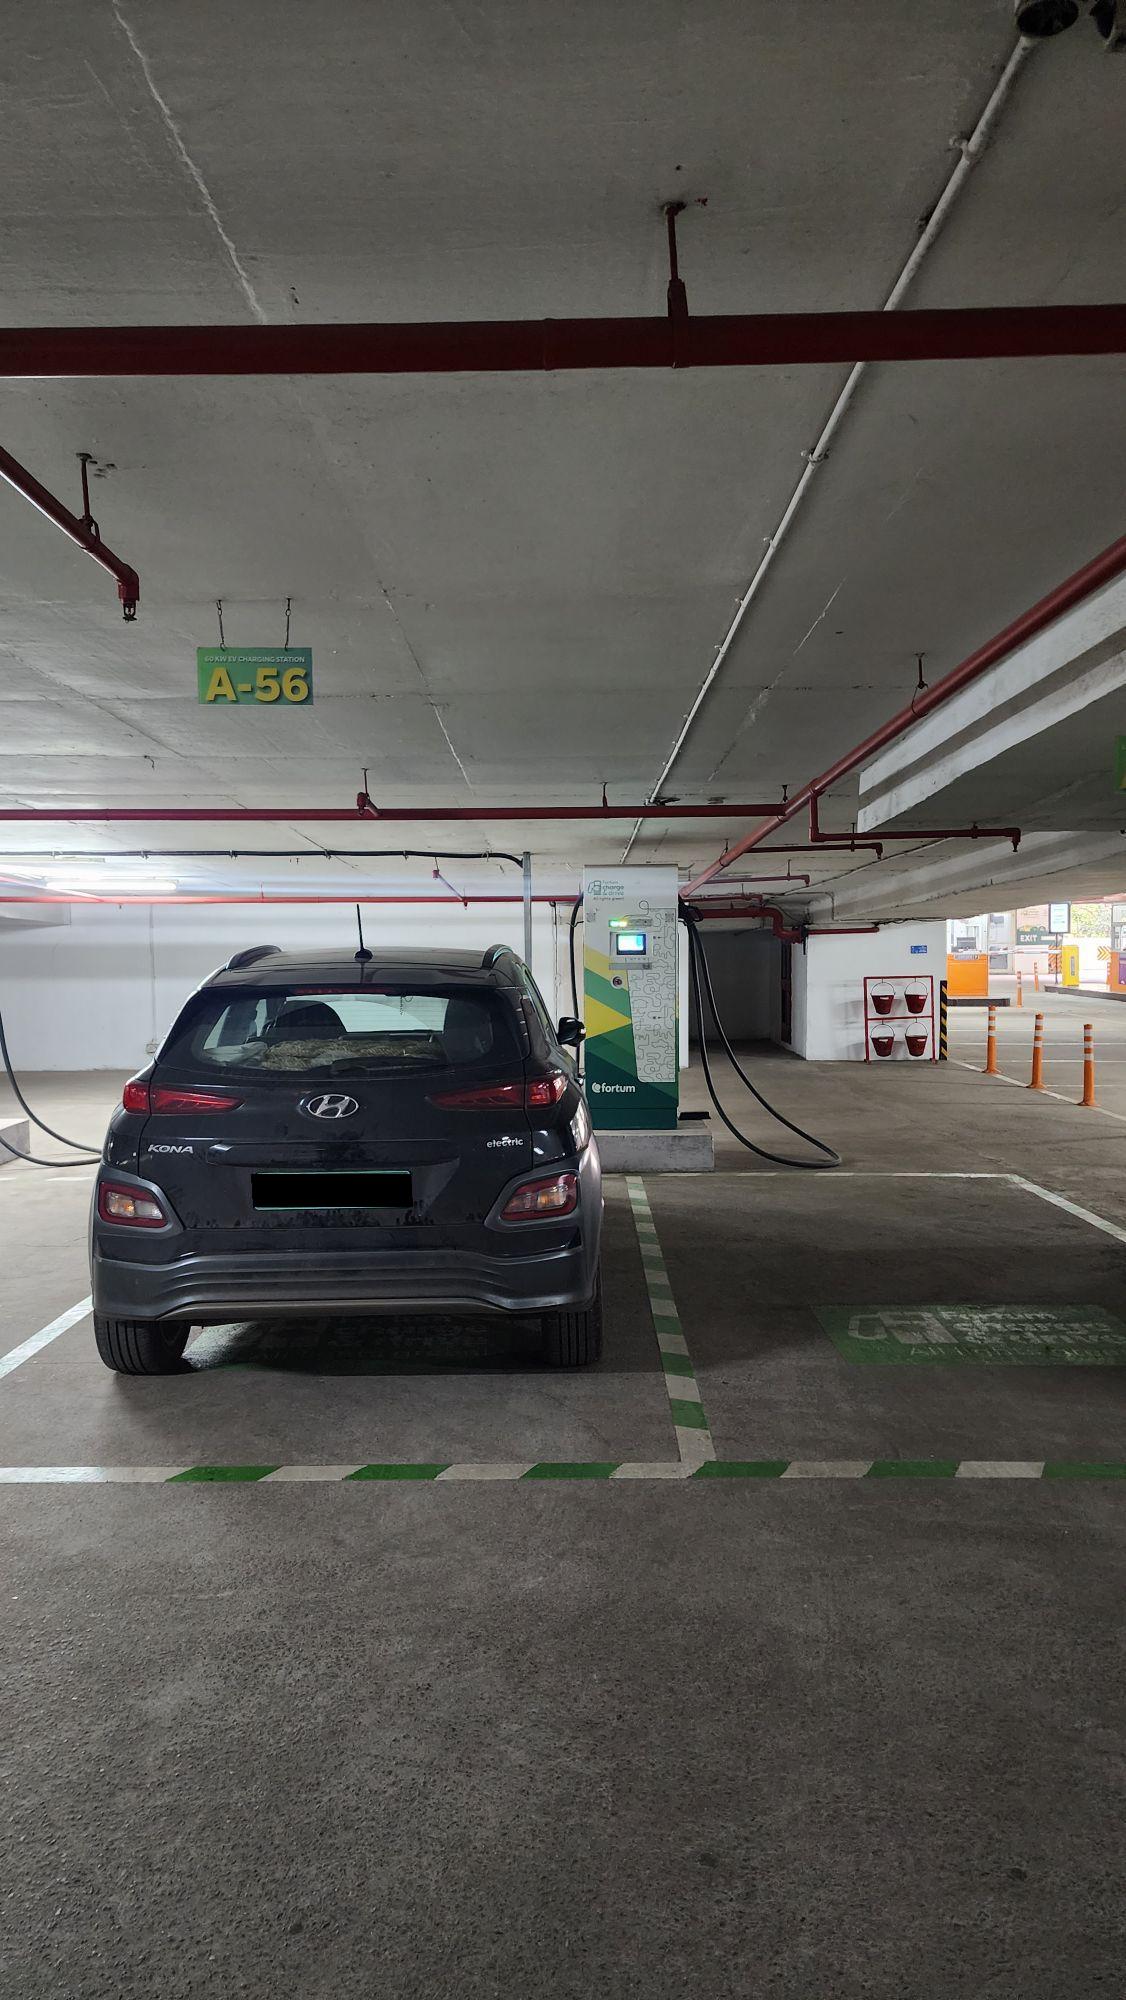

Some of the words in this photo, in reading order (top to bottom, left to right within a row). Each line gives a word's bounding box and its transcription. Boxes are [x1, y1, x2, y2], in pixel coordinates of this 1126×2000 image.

[206, 667, 309, 702] A-56
[1020, 934, 1038, 942] EXIT
[601, 1082, 636, 1093] fortum
[486, 1137, 524, 1148] electric
[147, 1144, 194, 1154] KONA
